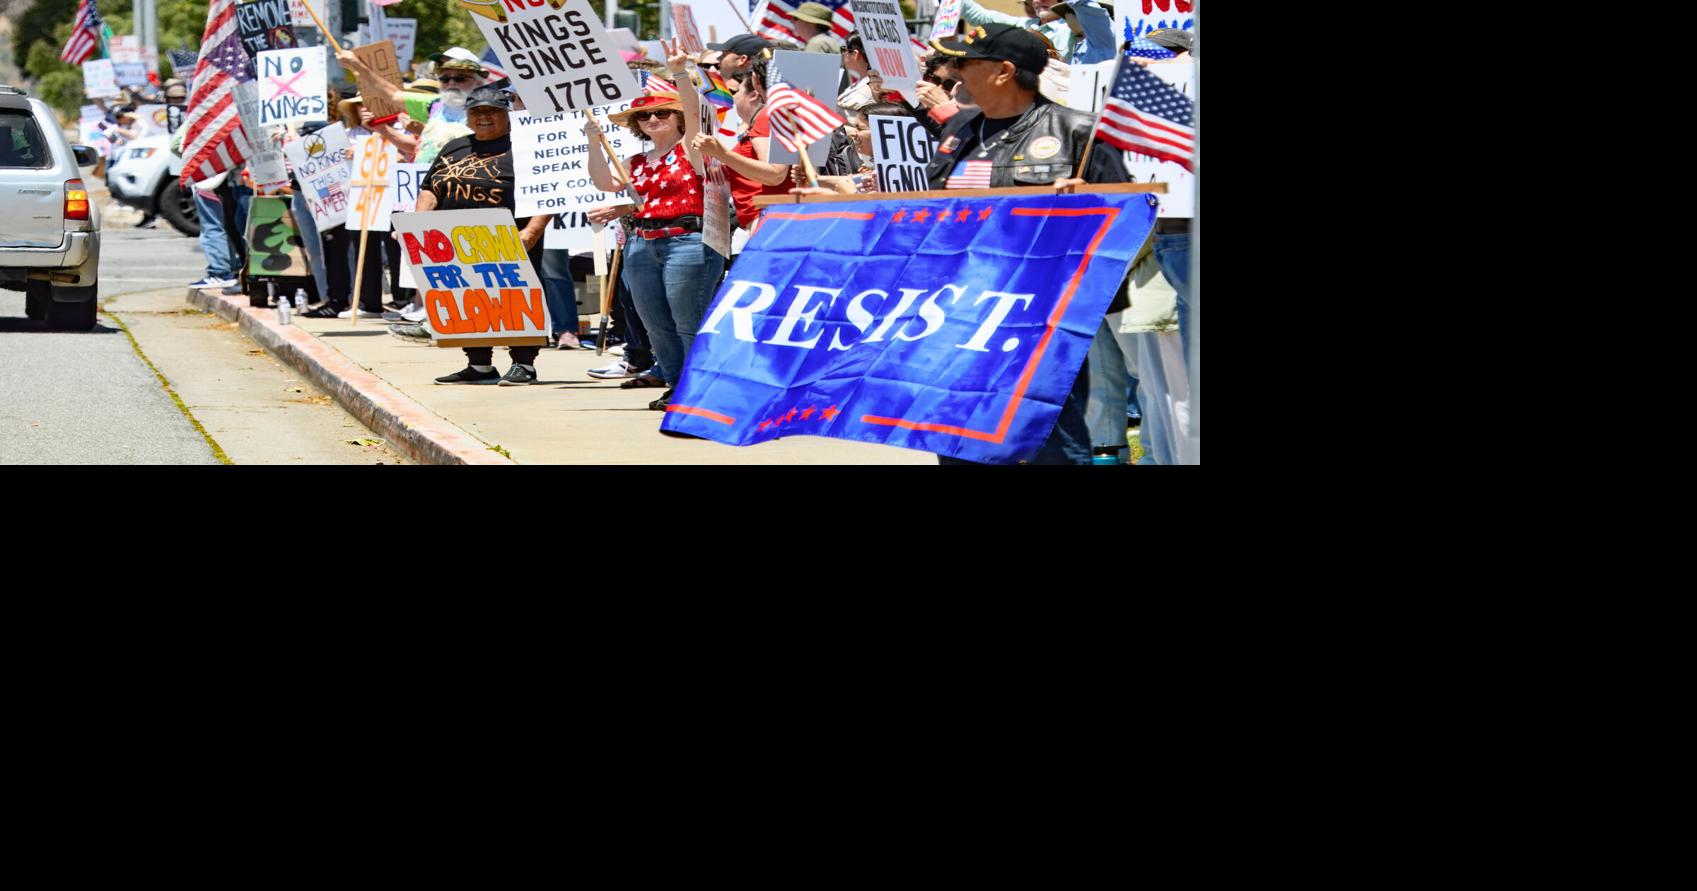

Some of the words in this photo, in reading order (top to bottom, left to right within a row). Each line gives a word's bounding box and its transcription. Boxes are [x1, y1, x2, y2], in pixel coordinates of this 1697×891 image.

[237, 0, 292, 34] REMOVE
[244, 33, 269, 52] THE
[494, 10, 591, 52] KINGS
[872, 18, 901, 44] RAIDS
[264, 56, 304, 78] NO
[510, 37, 607, 80] SINCE
[874, 46, 907, 78] NOW
[544, 73, 622, 113] 1776
[261, 95, 325, 124] KINGS.
[518, 113, 564, 126] WHEN
[537, 131, 568, 143] FOR
[579, 124, 621, 137] YUR
[534, 138, 622, 160] NEIGHBS
[299, 161, 317, 178] NO
[318, 148, 346, 169] KINGS
[337, 167, 348, 179] IS
[532, 160, 582, 175] SPEAK
[432, 178, 504, 204] KINGS
[520, 181, 559, 195] THEY
[537, 196, 567, 209] FOR
[575, 192, 606, 204] YOU
[402, 229, 455, 265] NO
[451, 224, 529, 265] CROWN
[423, 264, 471, 288] FOR
[472, 263, 529, 288] THE
[425, 288, 546, 334] CLOWN
[698, 280, 1035, 352] RESIST.
